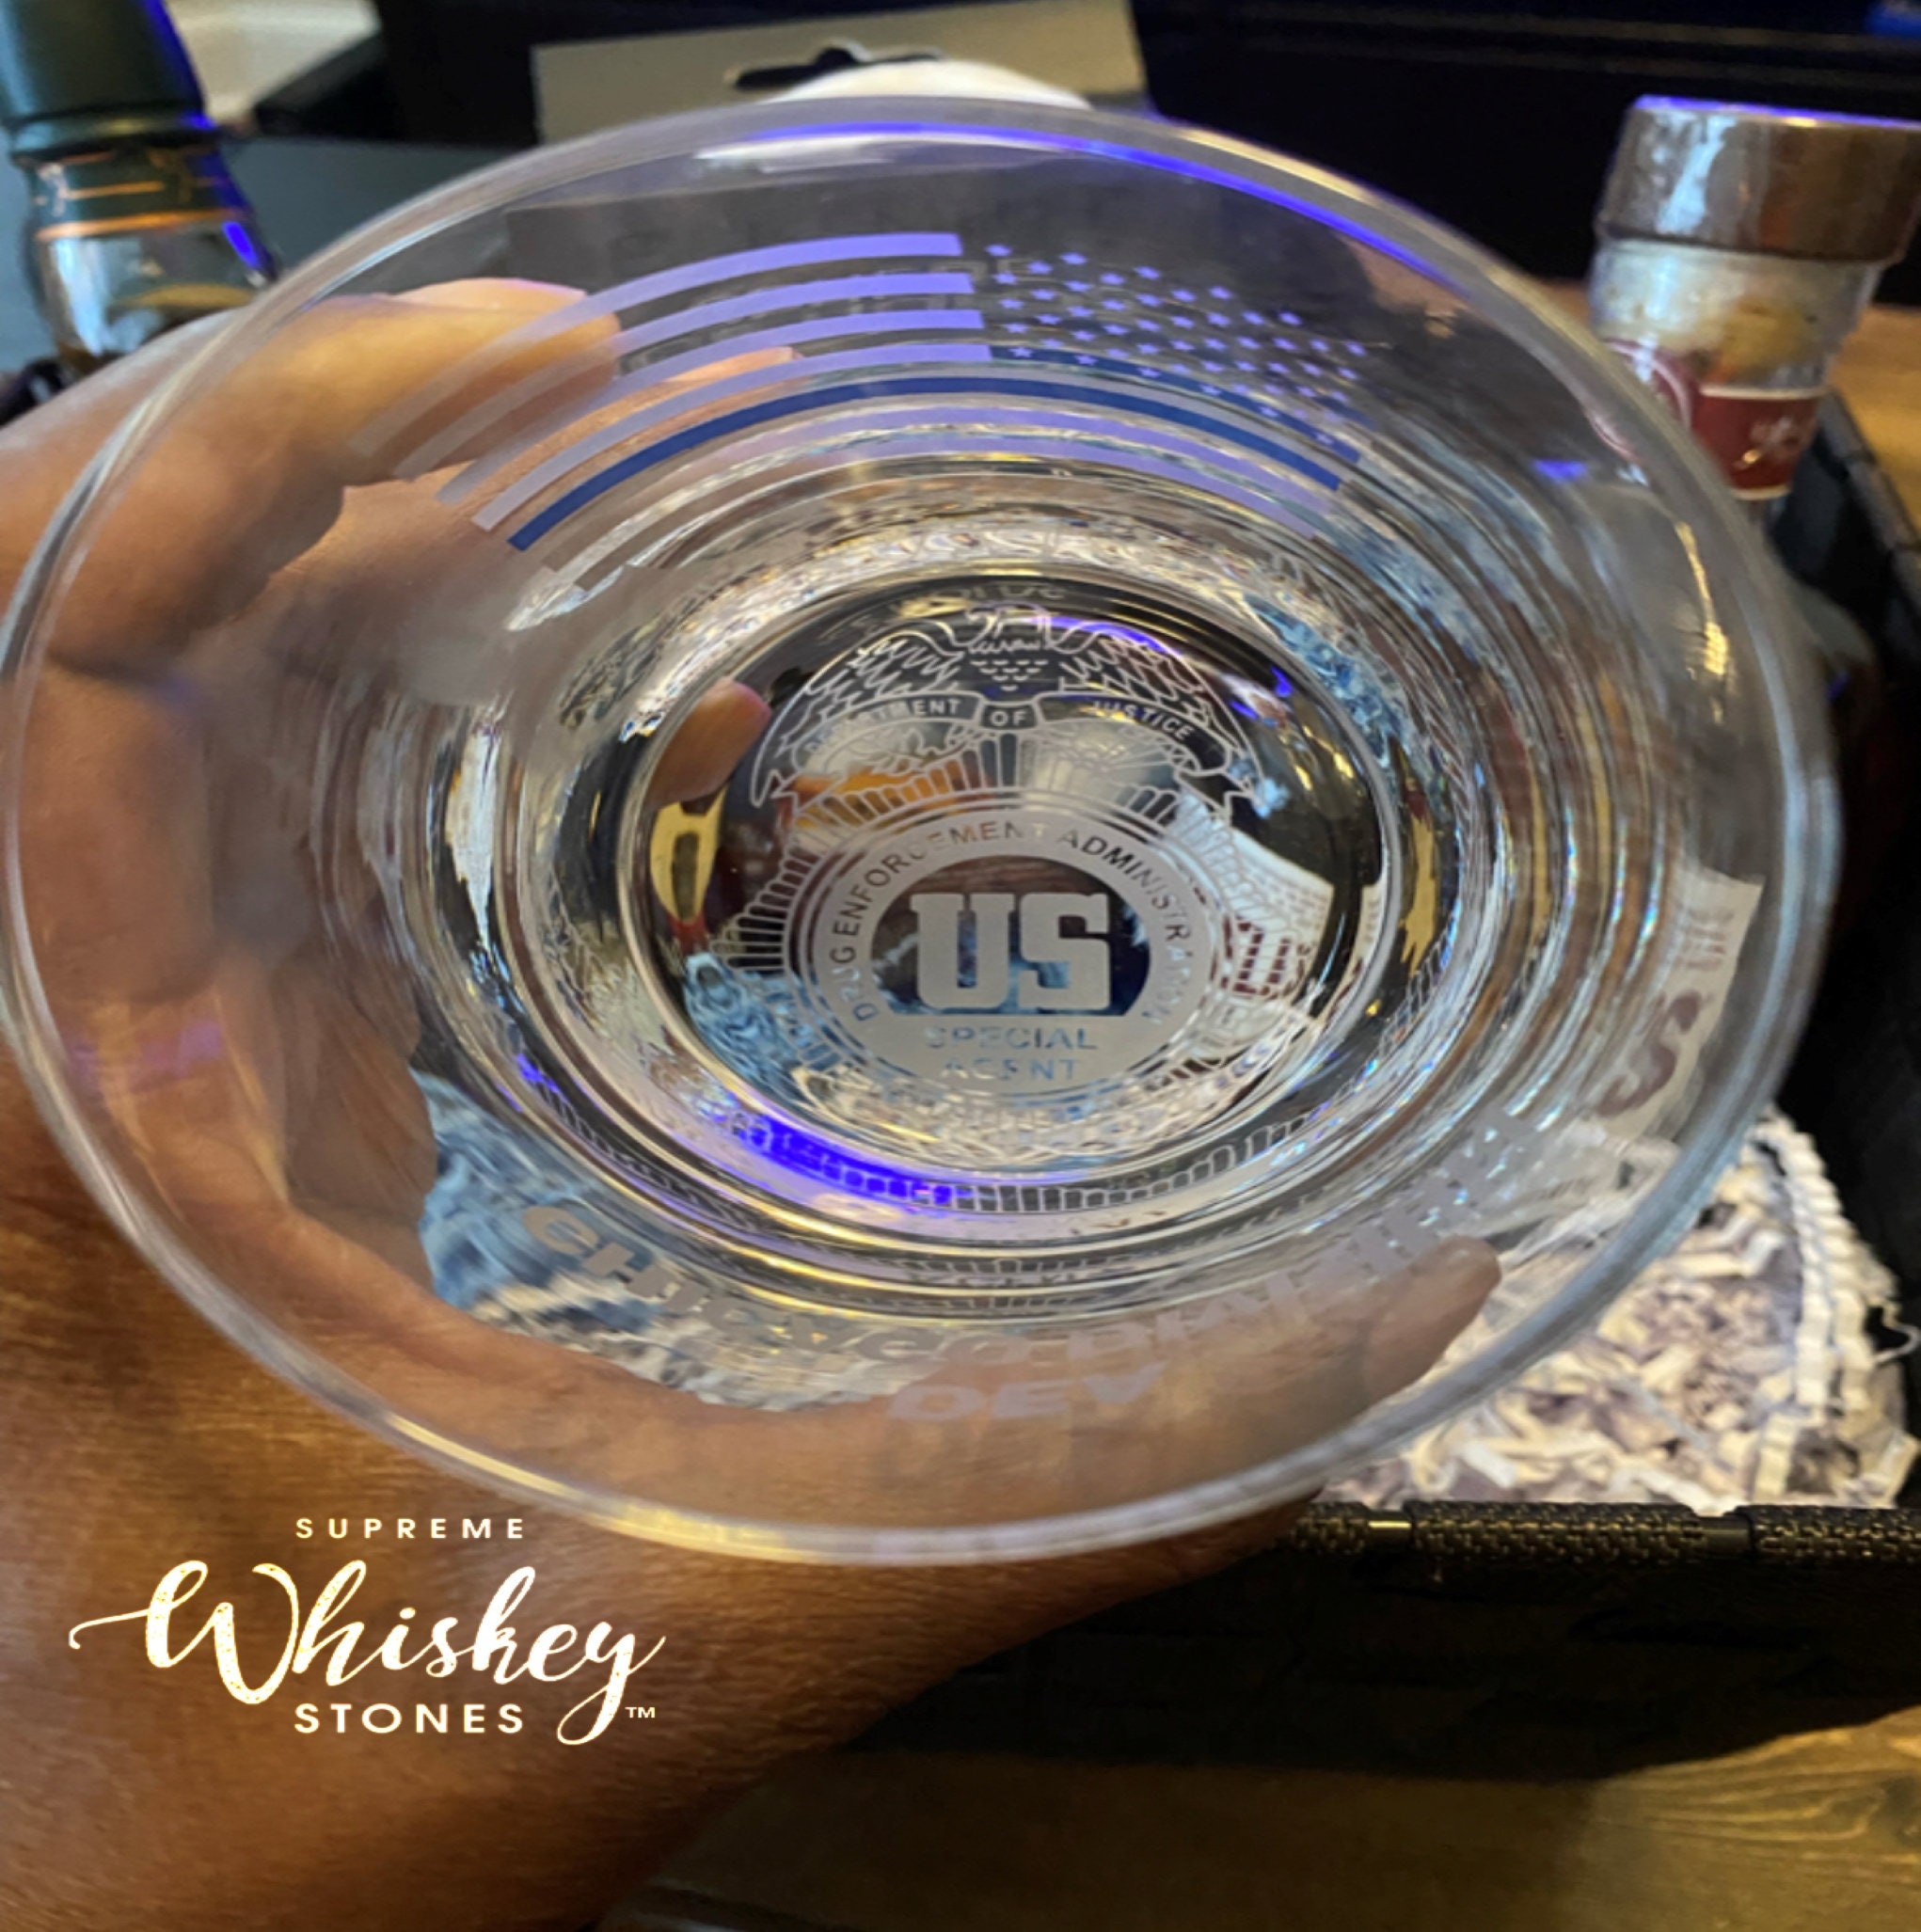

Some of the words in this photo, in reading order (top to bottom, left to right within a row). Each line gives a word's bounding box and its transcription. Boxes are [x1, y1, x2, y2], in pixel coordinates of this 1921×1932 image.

[803, 698, 961, 753] DTMENT
[990, 710, 1027, 727] OF
[1092, 700, 1195, 740] JUSTICE
[832, 820, 1046, 937] ENFORCEMENT
[909, 893, 1110, 1009] US
[925, 1026, 1099, 1050] SPECIAL
